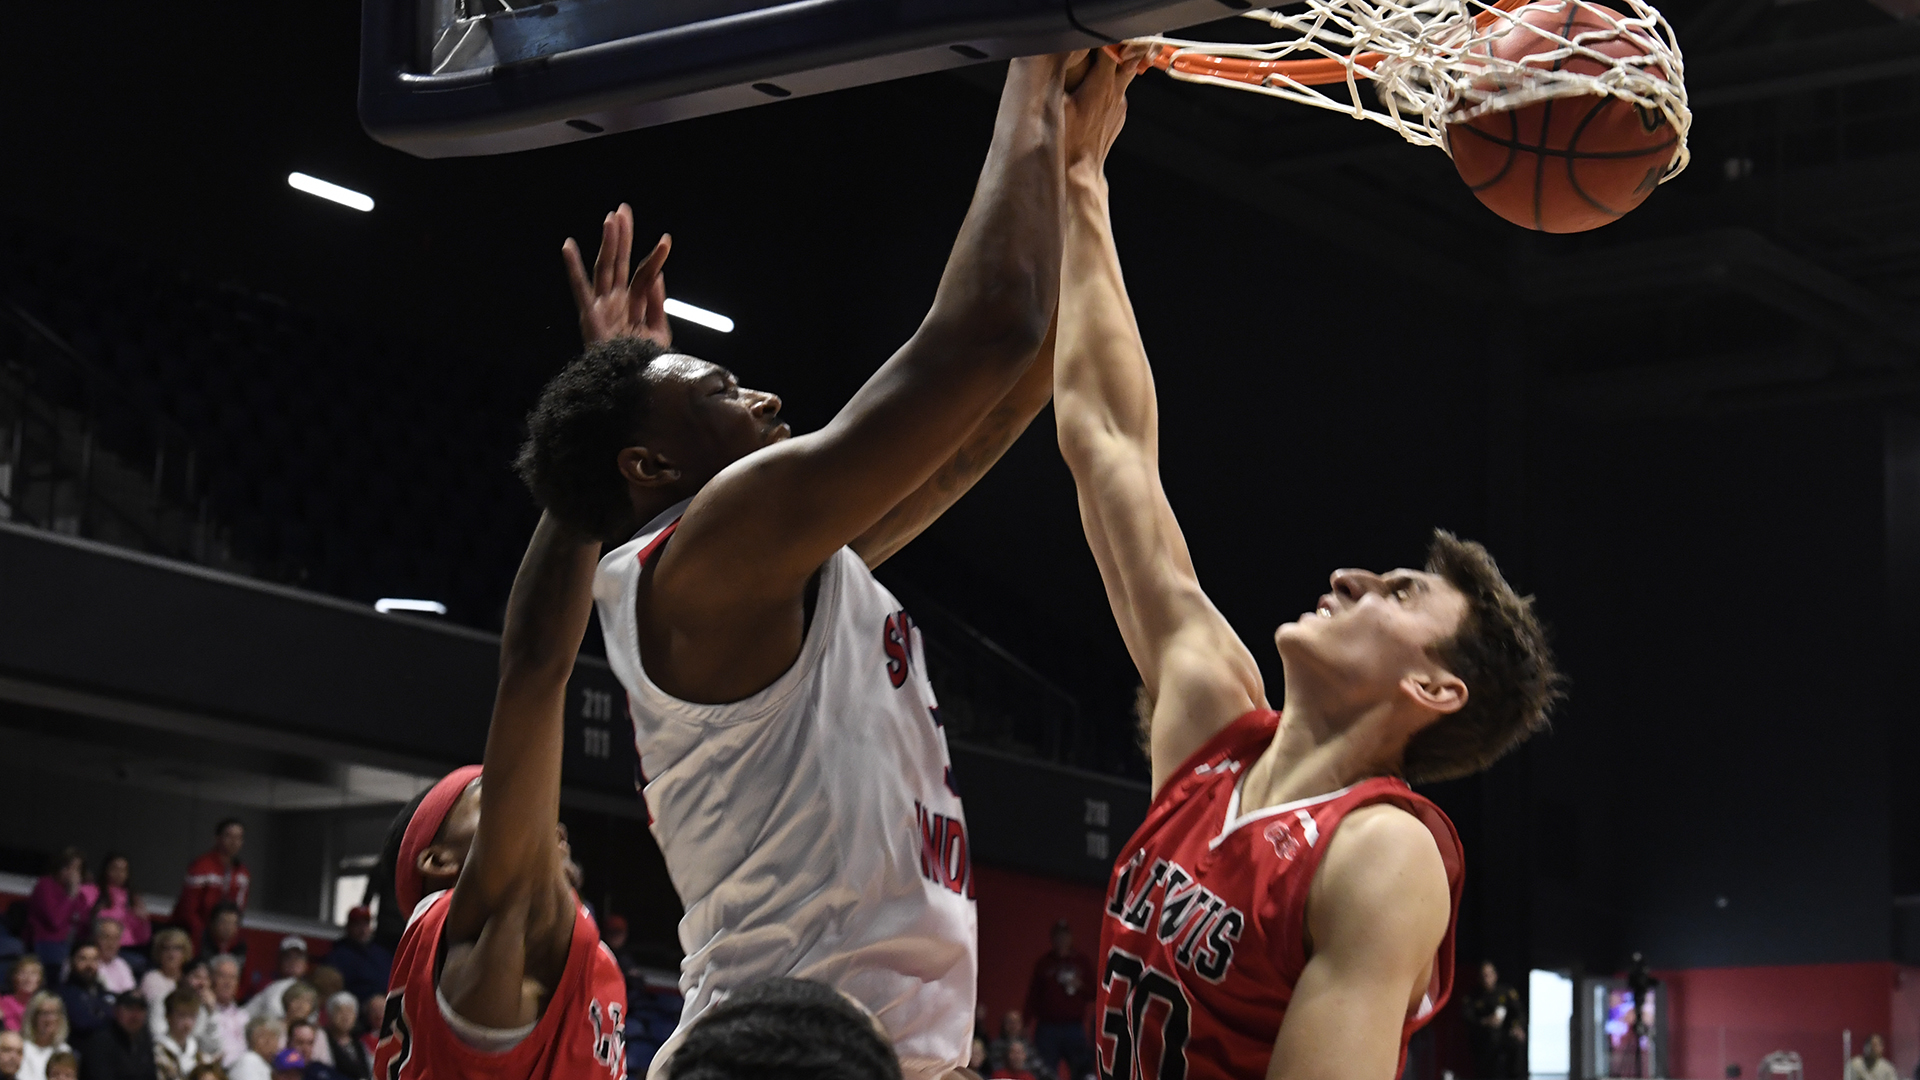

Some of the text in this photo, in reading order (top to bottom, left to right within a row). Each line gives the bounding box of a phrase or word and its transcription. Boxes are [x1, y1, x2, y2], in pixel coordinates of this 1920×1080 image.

[581, 687, 612, 722] 211
[583, 726, 611, 760] 111
[1096, 944, 1192, 1080] 30
